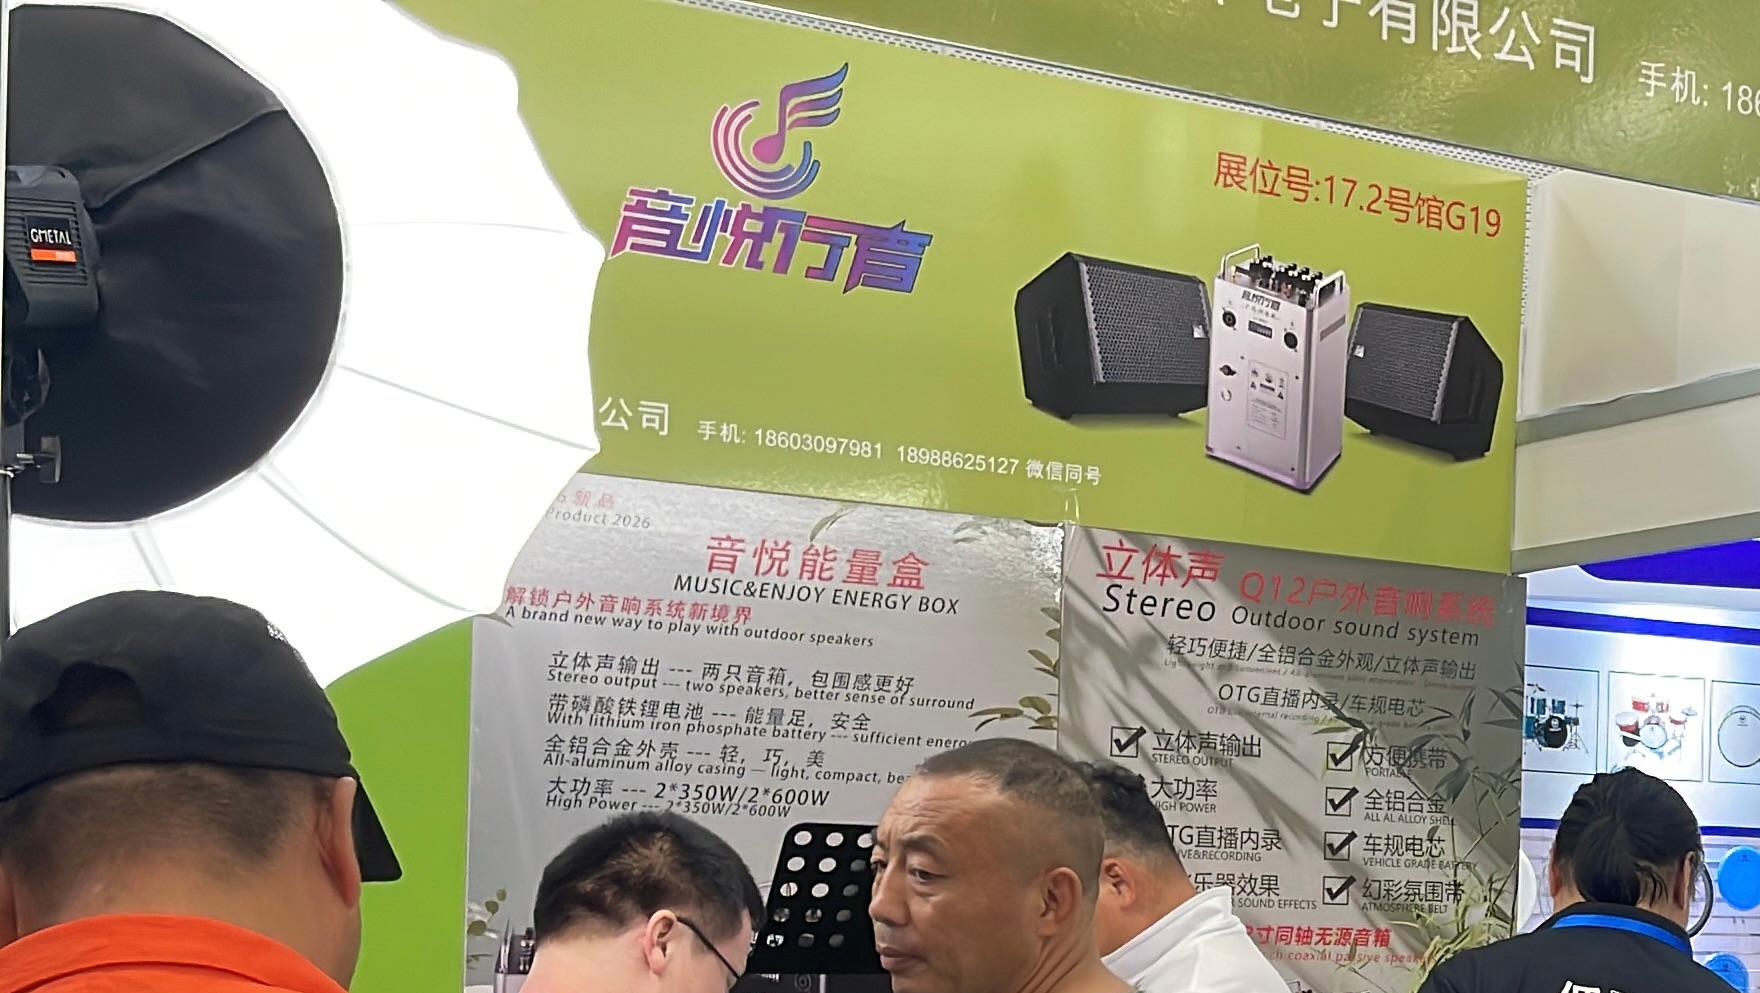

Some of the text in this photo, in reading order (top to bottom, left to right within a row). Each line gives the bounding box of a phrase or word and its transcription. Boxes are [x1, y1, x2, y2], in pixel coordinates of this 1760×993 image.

[1214, 151, 1502, 238] 展位号:17.2号馆G19
[599, 397, 670, 437] 公司
[755, 429, 883, 460] 18603097981
[897, 445, 1019, 476] 18988625127
[1025, 457, 1102, 487] 微信同号
[545, 507, 651, 530] Product 2026
[706, 533, 931, 591] 音悦能量盒
[674, 574, 960, 615] MUSIC&ENJOY ENERGY BOX
[1096, 538, 1498, 629] 立体声 Q12户外音响系统
[506, 585, 753, 626] 解锁户外音响系统新境界
[1103, 583, 1480, 649] Stereo Outdoor sound system
[505, 605, 874, 648] A brand new way to play with outdoor speakers
[549, 650, 660, 678] 立体声输出
[1166, 633, 1477, 682] 轻巧便捷/全铝合金外观/立体声输出
[547, 668, 598, 685] Stereo
[604, 675, 657, 690] output
[686, 680, 713, 693] two
[719, 683, 789, 700] speakers,
[794, 687, 840, 701] better
[845, 692, 886, 705] sense
[891, 692, 905, 705] of
[909, 696, 974, 710] surround
[1218, 683, 1426, 718] OTG直播内录/车规电芯
[549, 693, 704, 721] 带磷酸铁锂电池
[547, 711, 583, 727] With
[589, 714, 645, 730] lithium
[650, 719, 681, 732] iron
[686, 721, 767, 739] phosphate
[773, 725, 826, 743] battery
[853, 731, 921, 747] sufficient
[926, 736, 971, 749] ener
[1152, 728, 1262, 758] 立体声输出
[545, 733, 679, 761] 全铝合金外壳
[1152, 753, 1234, 768] STEREO OUTPUT
[543, 754, 650, 772] All-aluminum
[655, 759, 692, 775] alloy
[697, 763, 746, 779] casing
[771, 764, 809, 781] light,
[815, 769, 882, 785] compact,
[547, 776, 614, 798] 大功率
[1151, 775, 1218, 801] 大功率
[545, 795, 583, 812] High
[588, 796, 637, 811] Power
[1179, 803, 1217, 814] POWER
[1364, 789, 1447, 815] 全铝合金
[1364, 811, 1456, 826] ALL AL ALLOY SHELL
[1168, 824, 1282, 851] TG直播内录
[1363, 833, 1446, 859] 车规电芯
[1178, 849, 1262, 863] IVE&RECORDING
[1362, 857, 1401, 869] VEHICLE
[1403, 859, 1437, 871] GRADE
[1187, 872, 1280, 897] 乐器效果
[1361, 878, 1465, 904] 幻彩氛围带
[1238, 898, 1275, 910] SOUND
[1278, 900, 1318, 911] EFFECTS
[1361, 901, 1449, 915] ATMOSPHERE BELT
